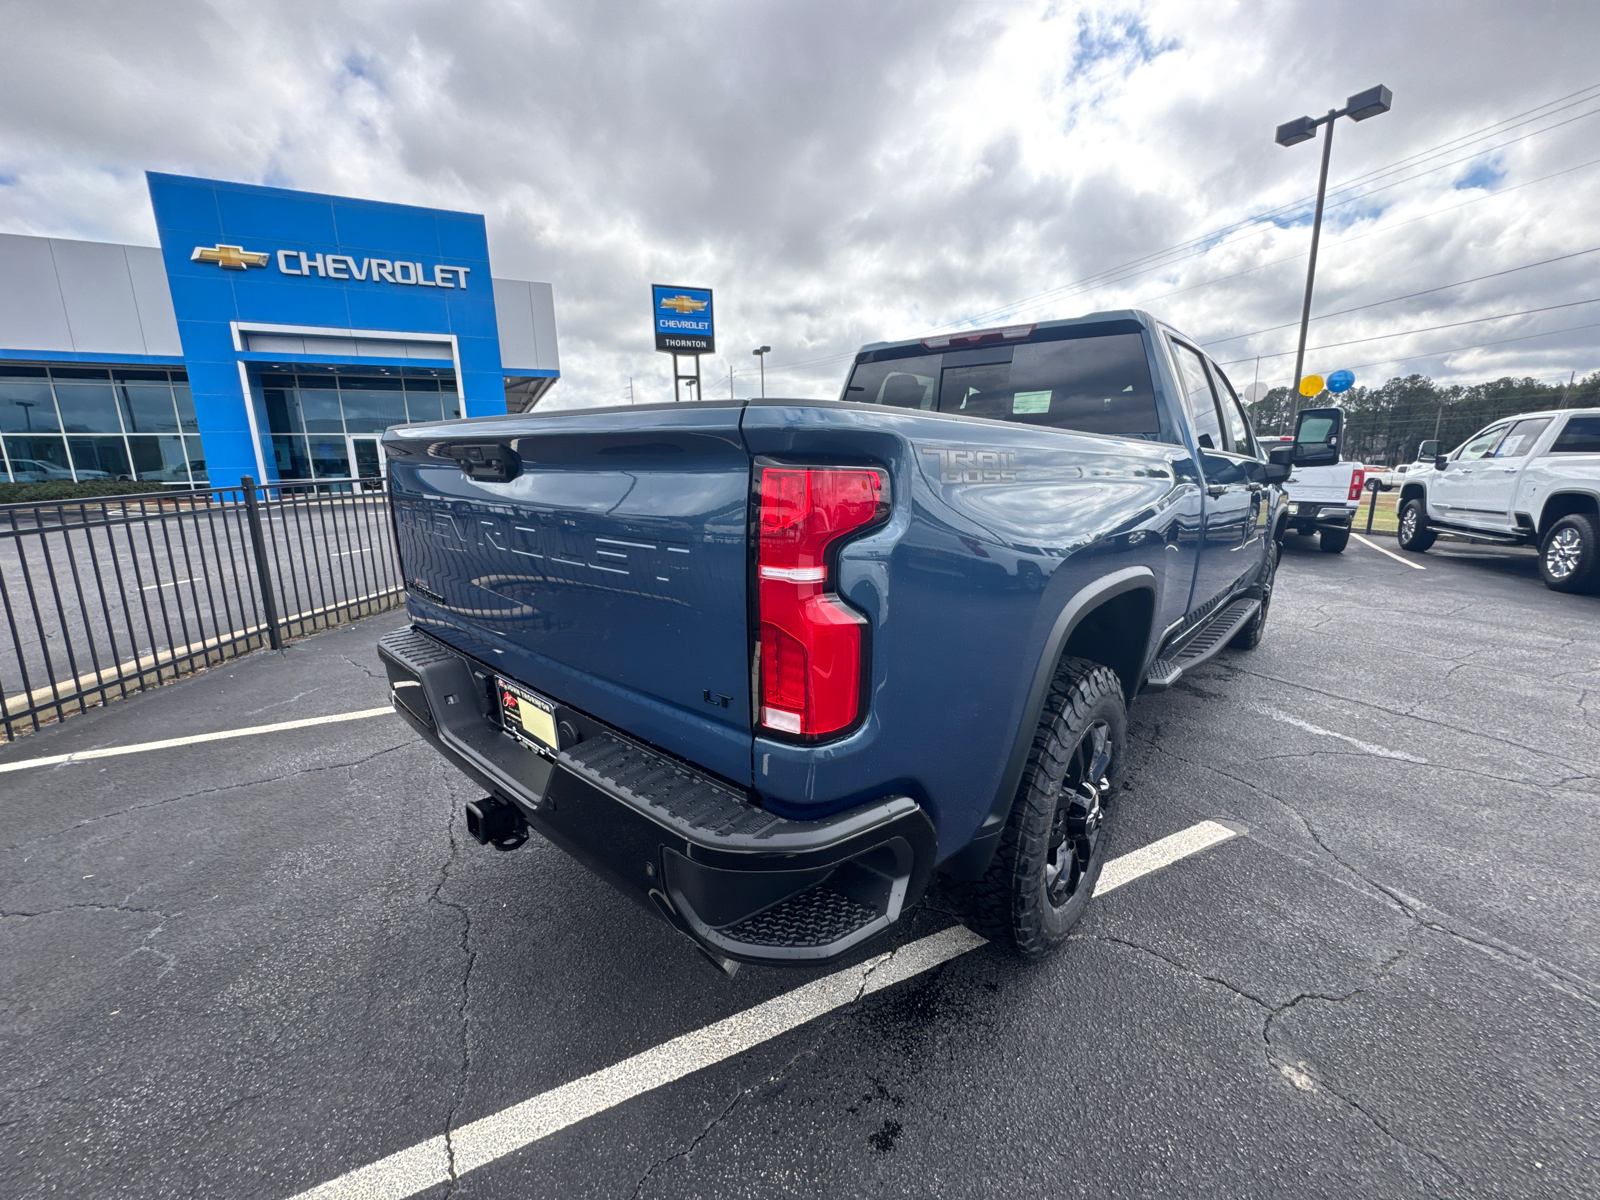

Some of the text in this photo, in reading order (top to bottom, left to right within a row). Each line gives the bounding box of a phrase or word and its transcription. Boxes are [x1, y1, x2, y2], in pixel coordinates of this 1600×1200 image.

[277, 250, 470, 289] CHEVROLET
[660, 319, 709, 330] CHEVROLET
[665, 339, 707, 348] THORNTON
[922, 447, 1026, 471] TRAIL
[941, 468, 1017, 484] BOSS
[703, 688, 733, 708] LT
